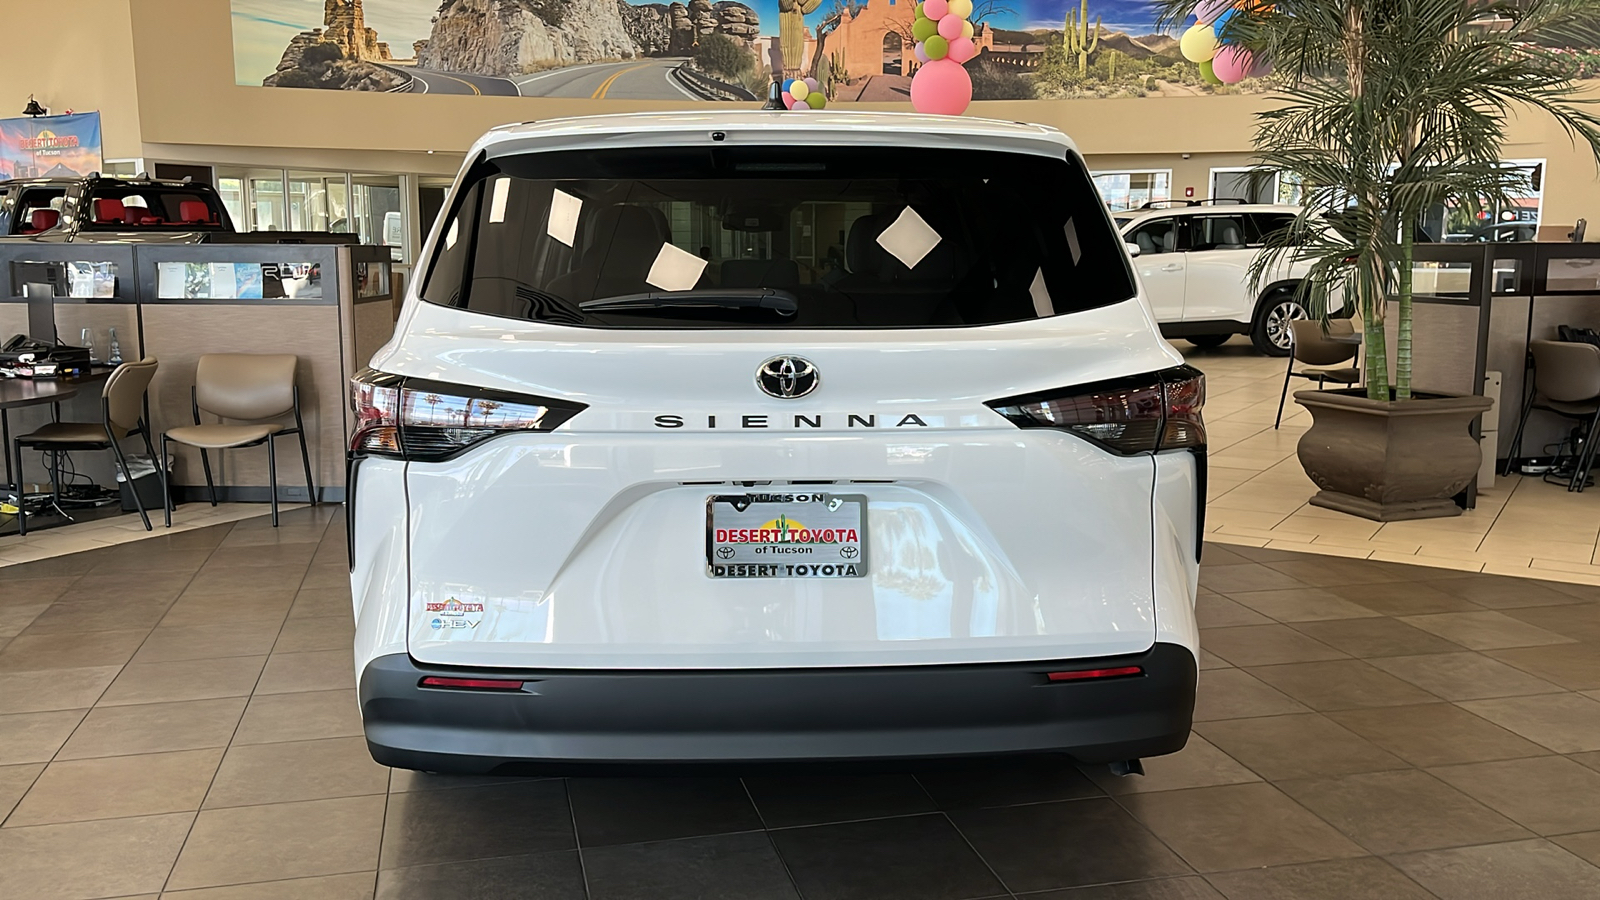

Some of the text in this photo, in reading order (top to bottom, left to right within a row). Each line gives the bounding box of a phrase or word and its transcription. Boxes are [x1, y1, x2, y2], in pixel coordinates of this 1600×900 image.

[20, 135, 79, 149] DESERT TOYOTA
[654, 414, 928, 428] SIENNA
[749, 493, 824, 502] TUCSON
[716, 529, 858, 543] DESERT TOYOTA
[755, 546, 813, 554] of Tucson
[714, 565, 857, 576] DESERT TOYOTA
